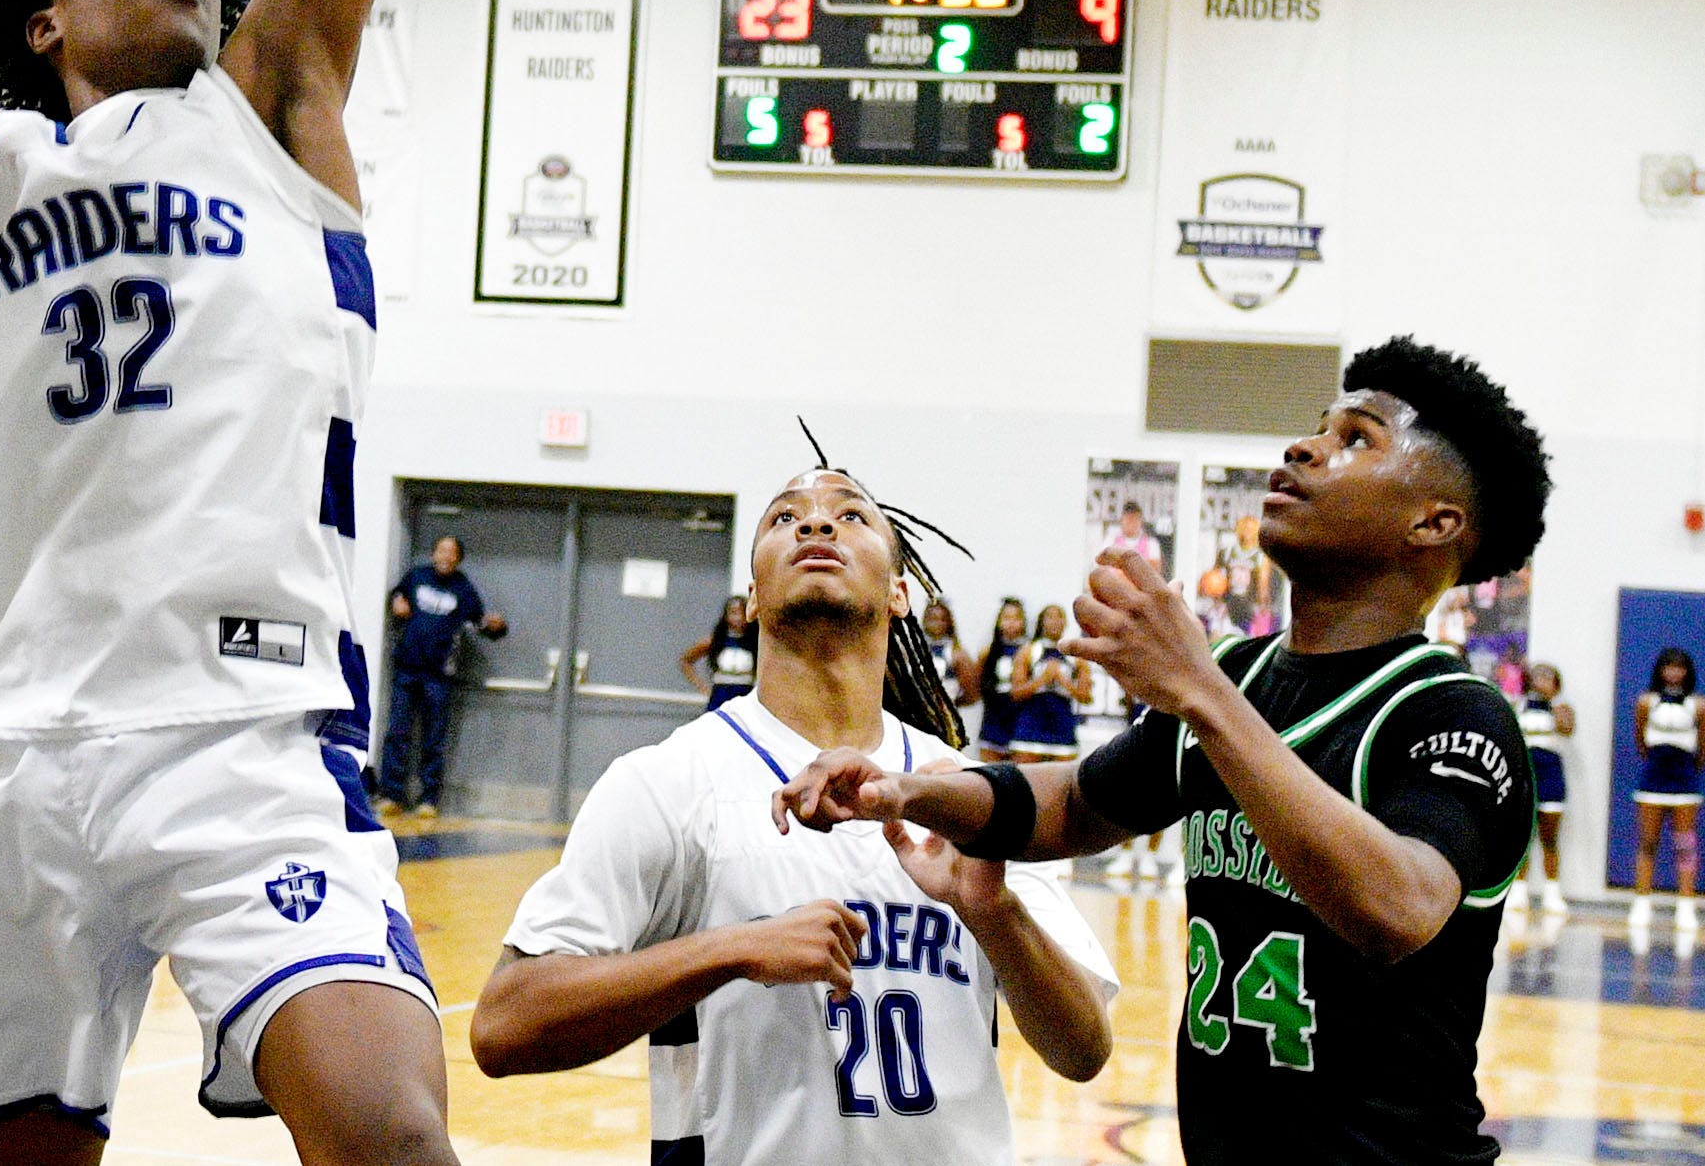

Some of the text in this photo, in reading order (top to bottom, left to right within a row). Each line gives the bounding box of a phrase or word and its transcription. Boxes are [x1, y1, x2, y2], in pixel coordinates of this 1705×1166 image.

[512, 10, 615, 34] HUNTINGTON
[760, 46, 821, 67] BONUS
[868, 35, 933, 55] PERIOD
[937, 24, 972, 73] 2
[527, 57, 595, 81] RAIDERS
[1016, 49, 1078, 71] BONUS
[726, 79, 779, 97] FOULS
[849, 82, 917, 101] PLAYER
[941, 83, 995, 103] FOULS
[1056, 85, 1111, 104] FOULS
[746, 96, 779, 146] 5
[803, 109, 832, 148] 5
[998, 114, 1026, 152] 5
[1079, 103, 1116, 154] 2
[1186, 225, 1314, 246] BASKETBALL
[512, 265, 589, 288] 2020
[41, 275, 176, 426] 32
[1183, 809, 1308, 906] OSSI
[1187, 916, 1317, 1072] 24
[825, 989, 938, 1118] 20
